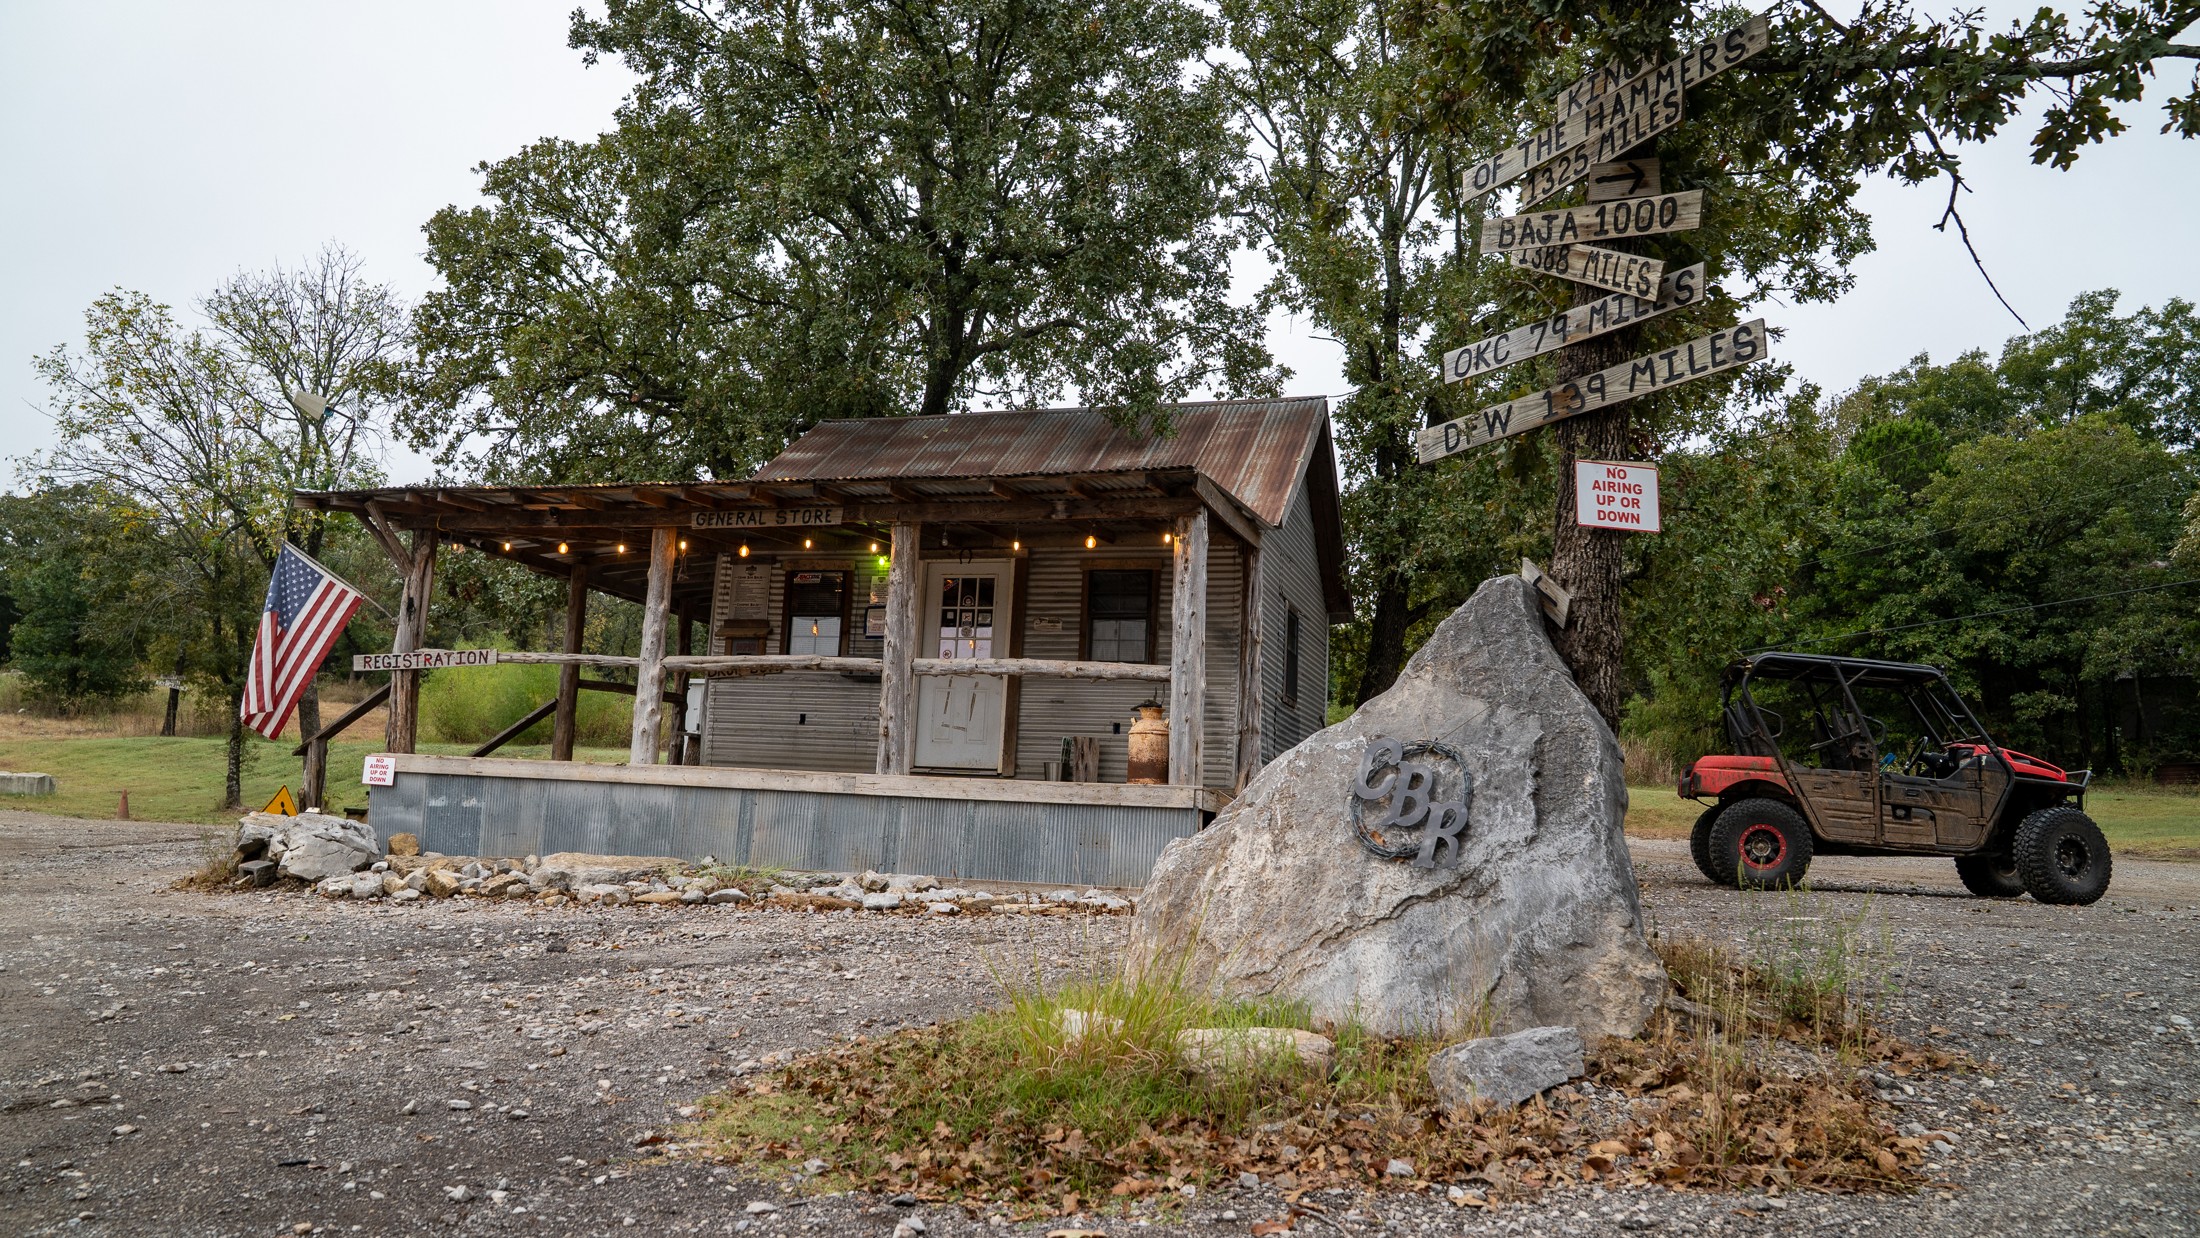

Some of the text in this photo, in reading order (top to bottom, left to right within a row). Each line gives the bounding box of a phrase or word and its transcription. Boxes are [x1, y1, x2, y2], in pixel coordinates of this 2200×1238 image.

[1474, 28, 1746, 190] OF THE HAMMERS
[1526, 89, 1680, 205] 1325 MILES
[1500, 197, 1678, 249] BAJA 1000
[1582, 250, 1651, 297] MILES
[1454, 335, 1511, 378] OKC
[1530, 314, 1568, 353] 79
[1542, 374, 1607, 422] 139
[1629, 325, 1758, 392] MILES
[1591, 479, 1643, 495] AIRING
[1606, 467, 1627, 480] NO
[696, 508, 833, 527] GENERAL STORE
[1596, 494, 1641, 509] UP OR
[1597, 509, 1640, 525] DOWN
[363, 650, 489, 669] REGISTRATION
[1354, 737, 1469, 869] CBR
